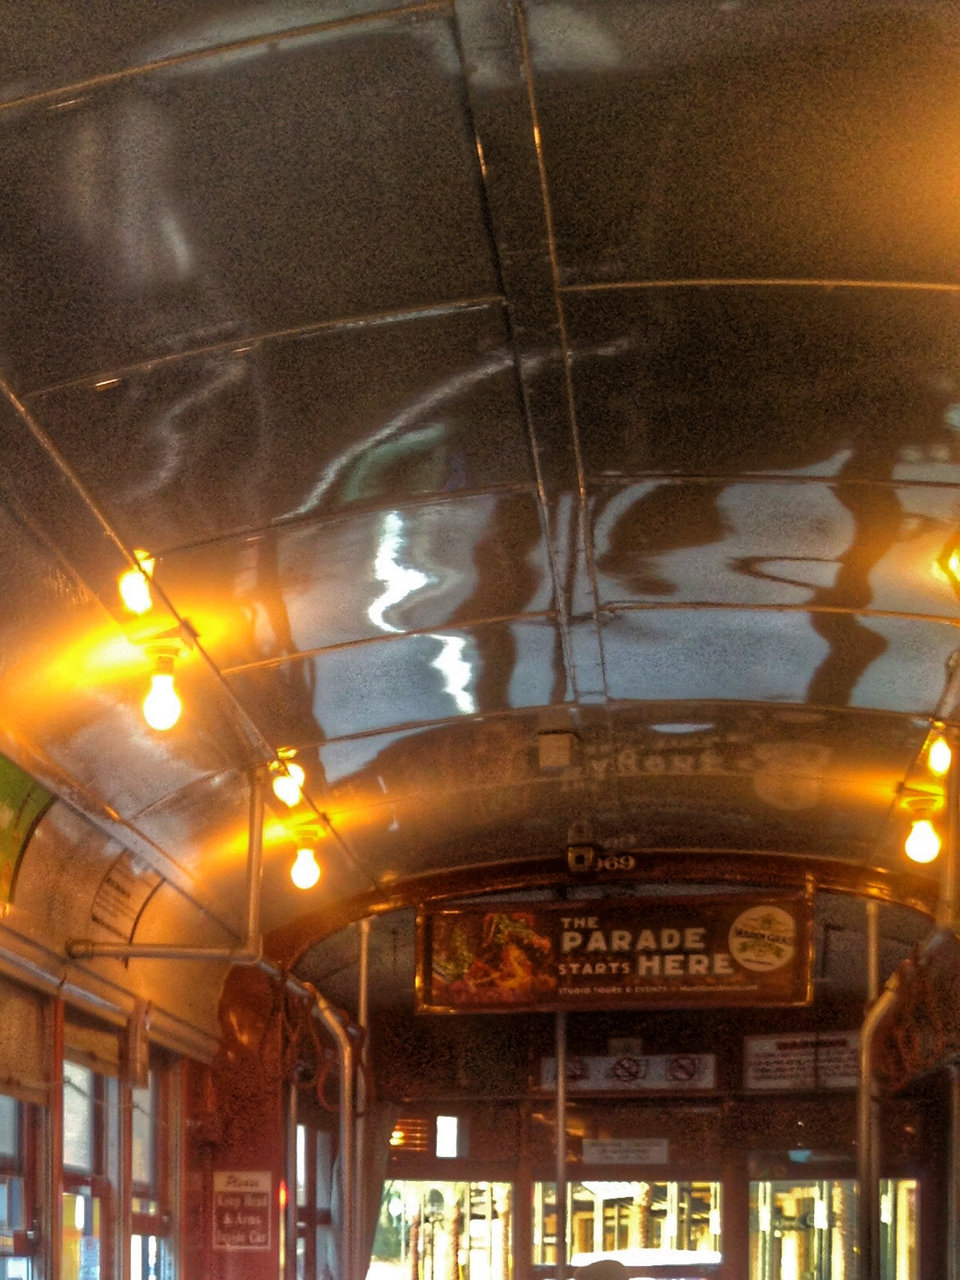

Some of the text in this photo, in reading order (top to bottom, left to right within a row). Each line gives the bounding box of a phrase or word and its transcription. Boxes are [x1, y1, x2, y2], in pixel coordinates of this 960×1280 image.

[560, 917, 600, 929] THE
[561, 927, 707, 953] PARADE
[558, 961, 631, 976] STARTS
[638, 953, 735, 976] HERE
